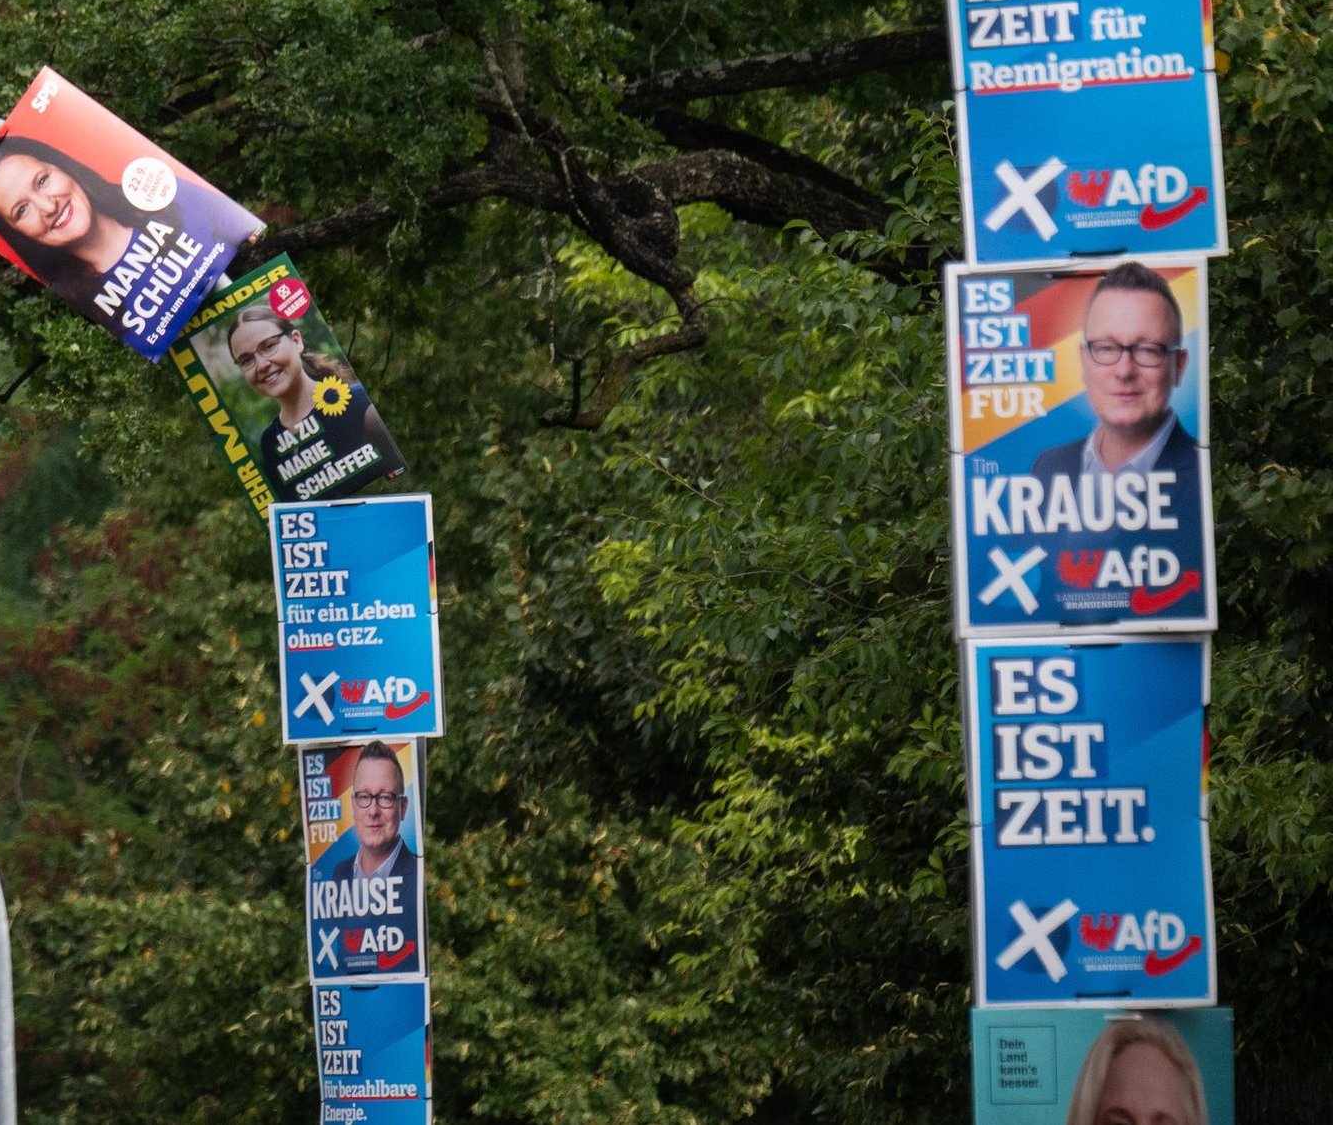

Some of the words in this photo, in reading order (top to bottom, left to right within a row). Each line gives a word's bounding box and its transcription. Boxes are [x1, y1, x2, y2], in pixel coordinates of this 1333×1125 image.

[969, 1, 1080, 49] ZEIT
[1090, 7, 1146, 41] für
[968, 47, 1195, 92] Remigration.
[31, 82, 58, 114] SPD
[1106, 163, 1188, 207] AfD
[93, 220, 174, 317] MANJA
[122, 232, 203, 335] SCHÜLE
[146, 332, 158, 345] Es
[156, 312, 174, 336] geht
[171, 297, 184, 313] um
[180, 242, 225, 298] Brandenburg.
[964, 281, 1012, 313] ES
[965, 315, 1028, 349] IST
[966, 350, 1053, 384] ZEIT
[169, 346, 249, 464] MUT
[276, 430, 298, 453] JA
[294, 415, 320, 441] ZU
[277, 439, 331, 481] MARIE
[295, 443, 379, 501] SCHÄFFER
[972, 458, 999, 475] Tim
[971, 471, 1179, 536] KRAUSE
[280, 512, 316, 539] ES
[282, 541, 328, 569] IST
[1095, 545, 1181, 588] AfD
[285, 570, 348, 599] ZEIT
[286, 604, 315, 624] für
[317, 602, 349, 623] ein
[351, 600, 416, 621] Leben
[287, 628, 334, 649] ohne
[336, 626, 384, 646] GEZ.
[363, 676, 417, 704] AfD
[991, 657, 1079, 716] ES
[305, 753, 324, 776] ES
[994, 723, 1104, 781] IST
[306, 776, 331, 799] IST
[308, 800, 341, 823] ZEIT
[998, 788, 1156, 847] ZEIT.
[313, 876, 403, 920] KRAUSE
[360, 925, 404, 954] AfD
[1115, 910, 1186, 952] AfD
[319, 990, 341, 1016] ES
[320, 1020, 348, 1046] IST
[999, 1039, 1025, 1050] Dein
[323, 1049, 362, 1075] ZEIT
[1000, 1051, 1027, 1063] Land
[1000, 1065, 1038, 1076] kann's
[324, 1079, 338, 1099] für
[338, 1078, 417, 1098] bezahlbare
[1000, 1078, 1043, 1089] besser.
[324, 1103, 367, 1125] Energie.
